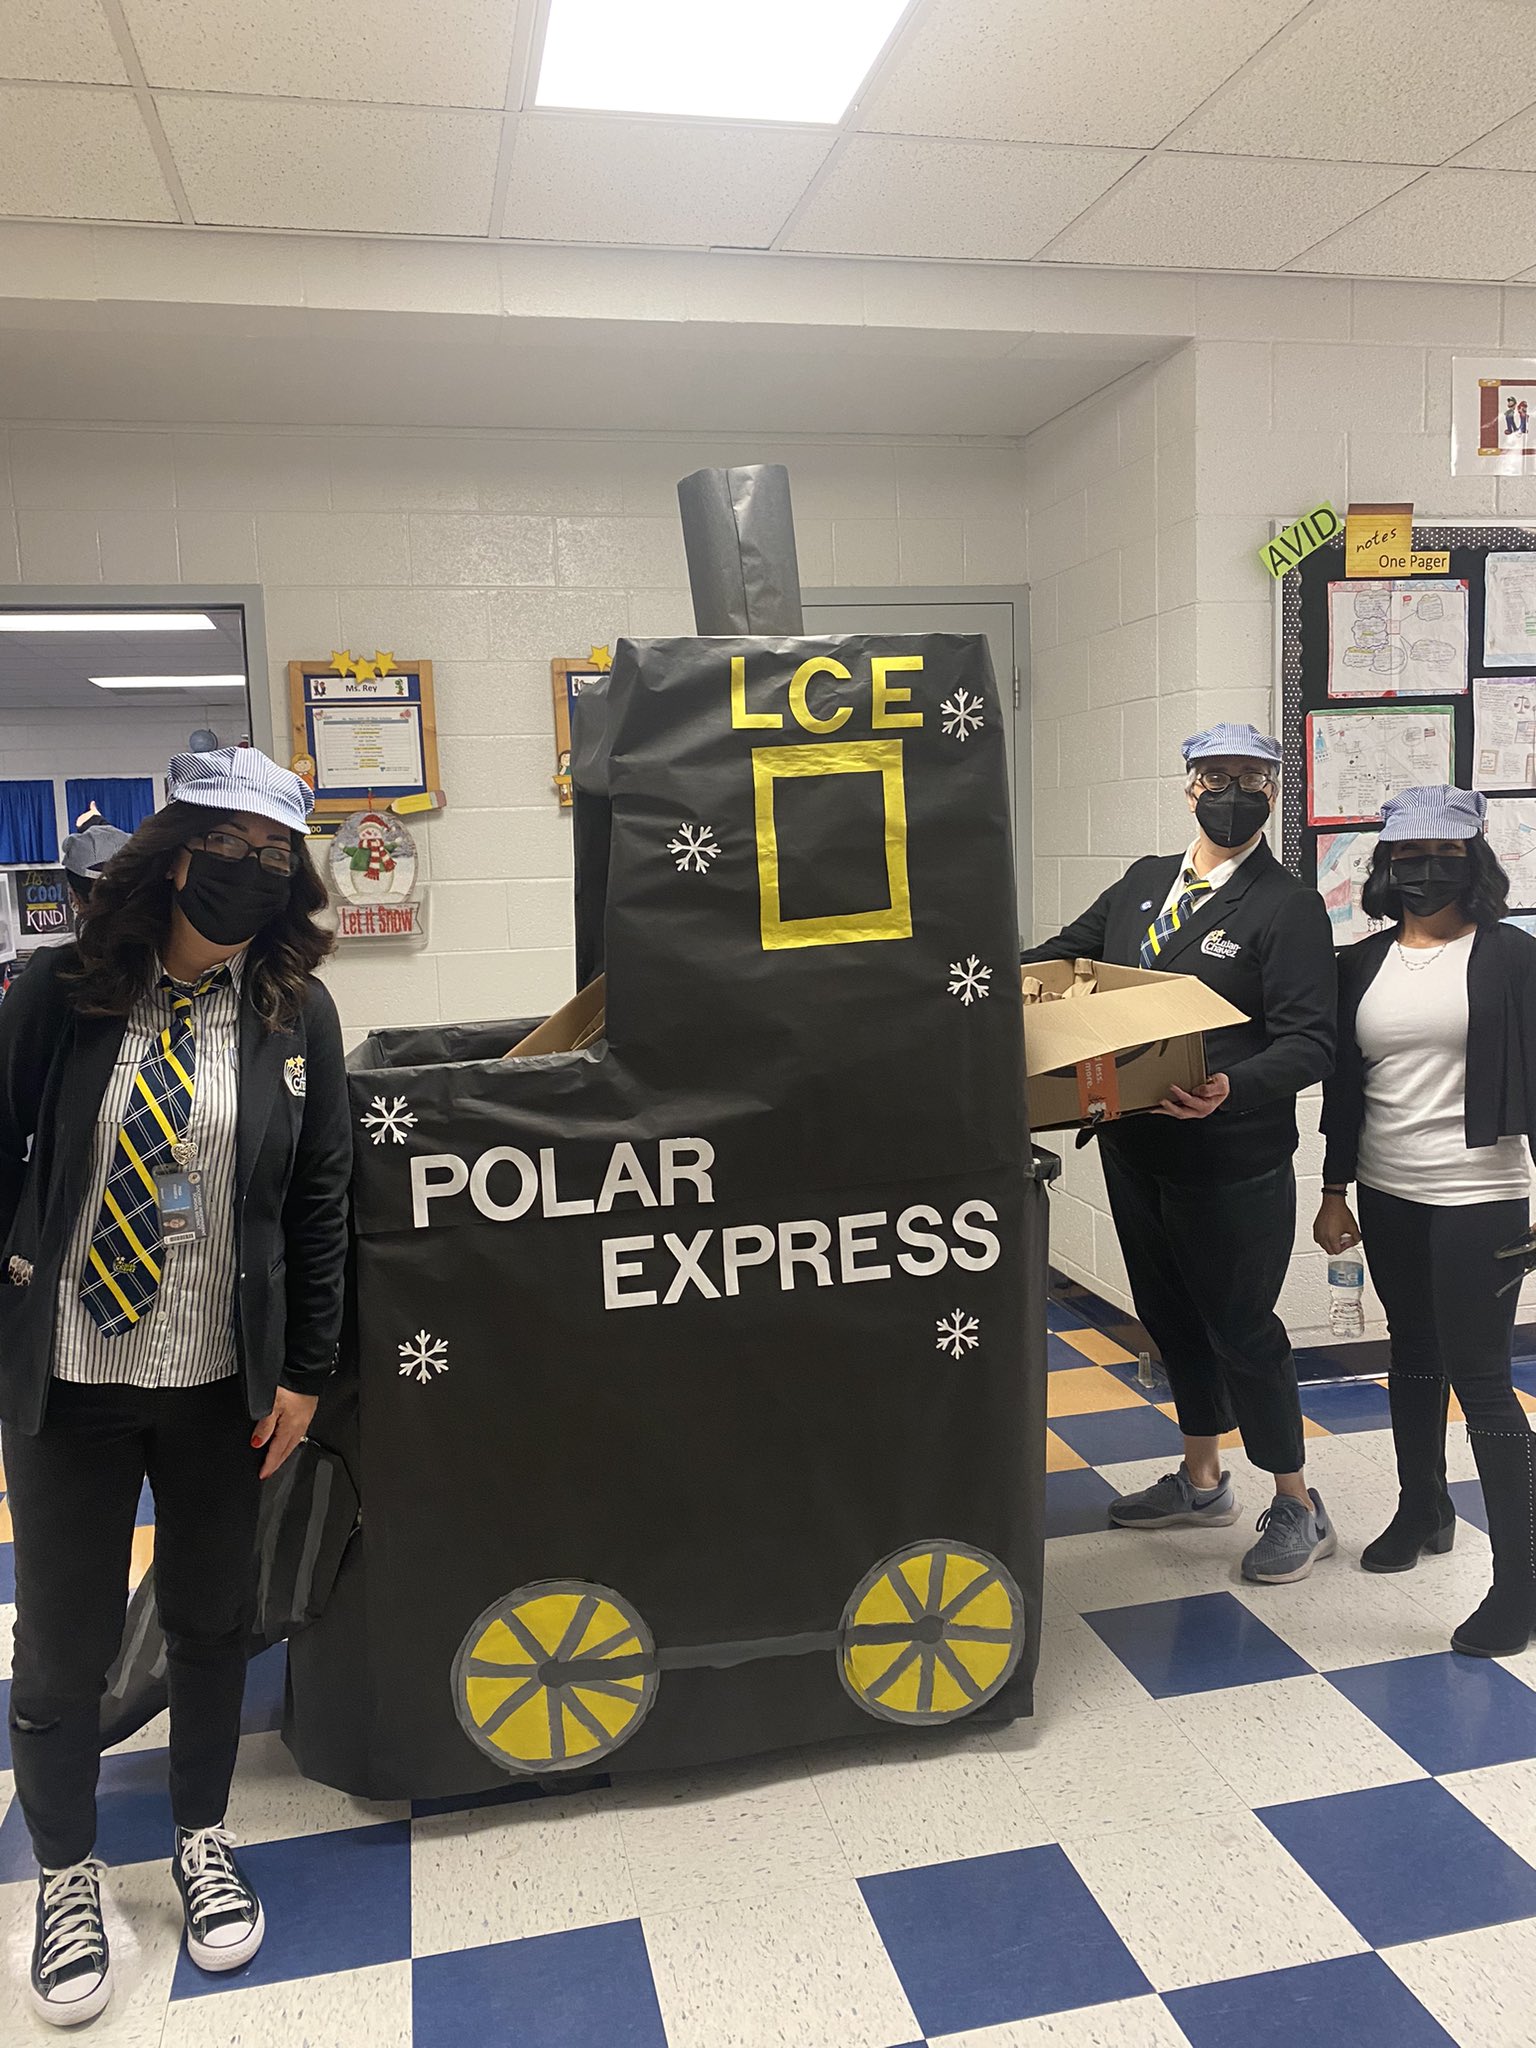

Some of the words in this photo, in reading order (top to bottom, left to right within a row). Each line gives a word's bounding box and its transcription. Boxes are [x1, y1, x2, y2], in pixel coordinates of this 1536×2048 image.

[1267, 508, 1338, 576] AVID
[1355, 527, 1398, 553] notes
[1378, 554, 1406, 569] One
[1410, 554, 1447, 570] Pager
[345, 684, 361, 692] Ms.
[362, 684, 378, 693] Rey
[730, 655, 924, 735] LCE
[310, 825, 322, 834] 00
[27, 883, 65, 903] COOL
[26, 903, 68, 932] KIND!
[342, 907, 363, 935] Let
[365, 905, 376, 934] it
[378, 904, 415, 934] Snow
[1204, 941, 1237, 959] Chavez
[409, 1136, 716, 1229] POLAR
[601, 1199, 1001, 1310] EXPRESS
